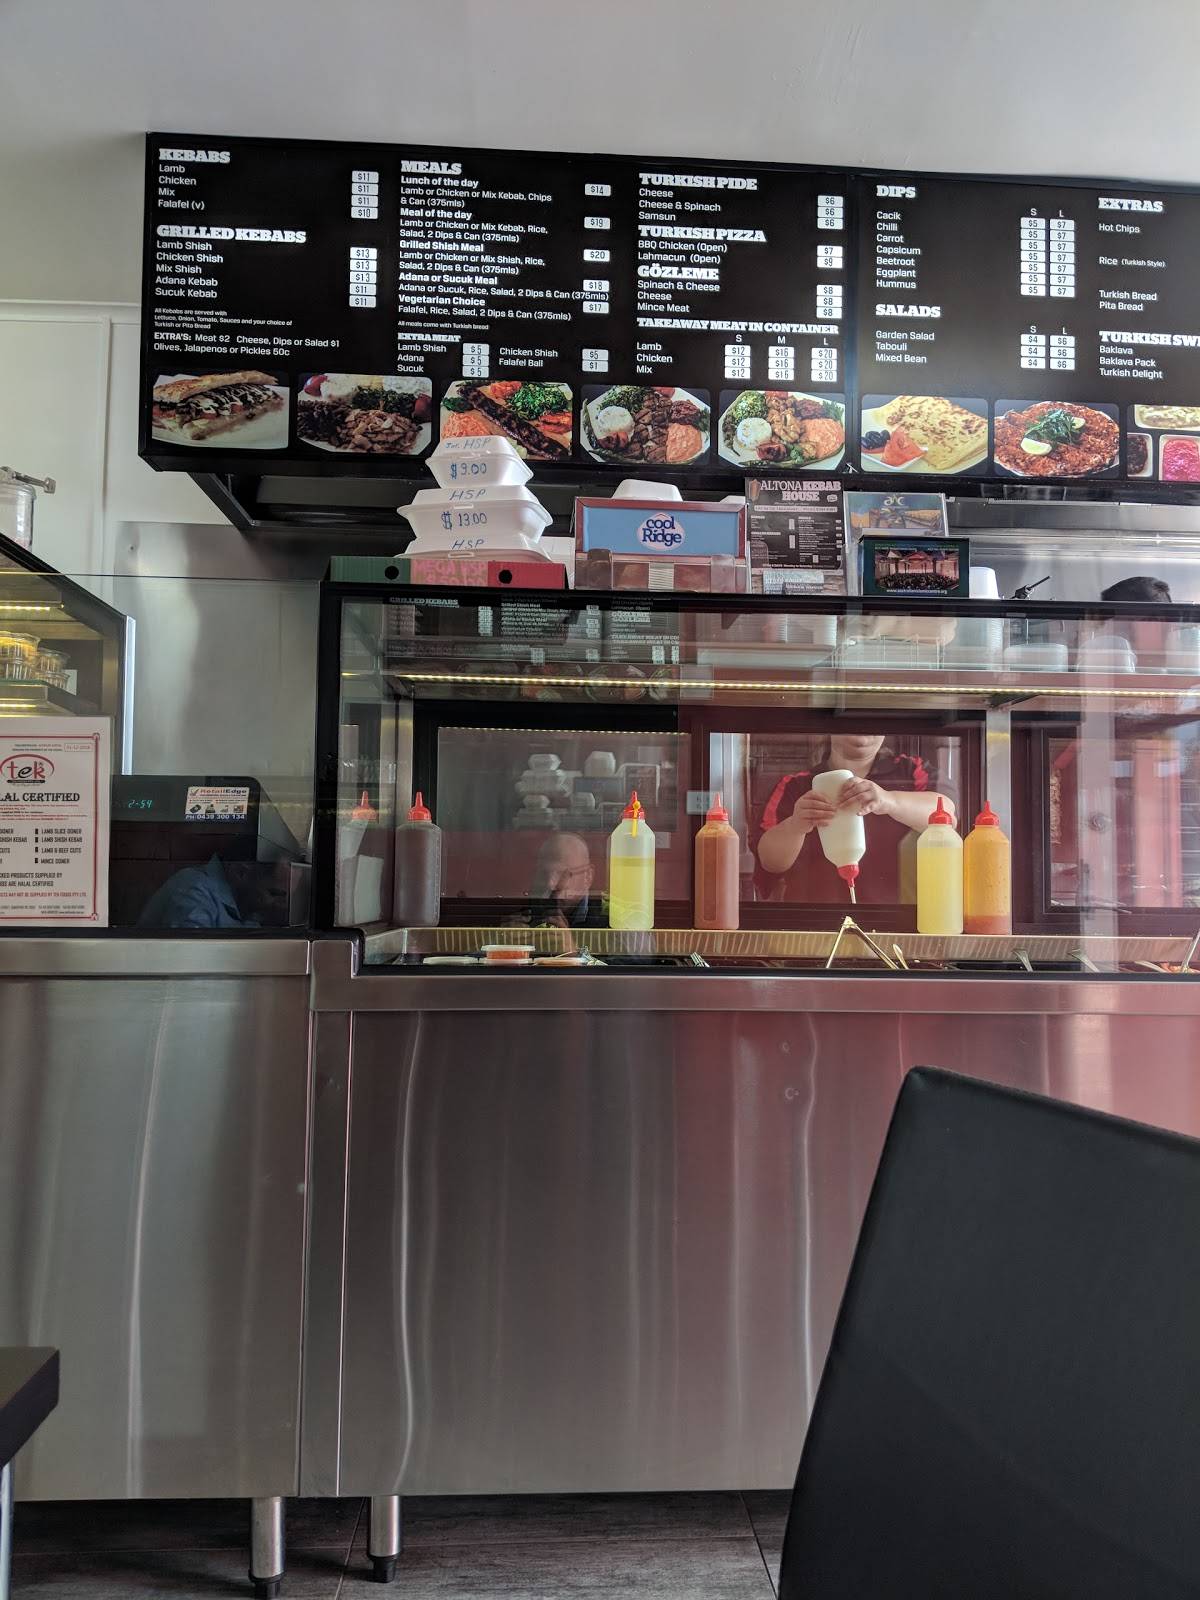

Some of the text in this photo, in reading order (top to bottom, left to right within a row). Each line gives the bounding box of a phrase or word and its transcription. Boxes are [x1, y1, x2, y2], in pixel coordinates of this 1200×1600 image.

[159, 148, 230, 163] KEBABS
[159, 164, 185, 173] Lamb
[401, 160, 462, 175] MEALS
[159, 176, 196, 185] Chicken
[401, 176, 479, 189] Lunch of the day
[639, 173, 757, 190] TURKISH PIDE
[159, 188, 175, 196] Mix
[591, 185, 604, 195] $14
[639, 188, 673, 197] Cheese
[877, 185, 916, 198] DIPS
[158, 199, 205, 210] Falafel (v)
[639, 200, 673, 209] Cheese
[684, 202, 721, 211] Spinach
[1098, 198, 1163, 212] EXTRAS
[358, 209, 370, 217] $10
[400, 208, 472, 220] Meal of the day
[639, 211, 676, 221] Samsun
[877, 211, 901, 220] Cacik
[590, 218, 603, 228] $19
[877, 223, 897, 231] Chilli
[638, 225, 766, 242] TURKISH PIZZA
[1099, 223, 1140, 234] Hot Chips
[157, 225, 306, 243] GRILLED KEBABS
[877, 234, 904, 243] Carrot
[157, 240, 212, 250] Lamb Shish
[400, 240, 484, 252] Grilled Shish Meal
[638, 240, 727, 253] BBQ Chicken (Open)
[877, 245, 921, 255] Capsicum
[157, 252, 223, 263] Chicken Shish
[590, 251, 605, 260] $20
[638, 252, 720, 264] Lahmacun (Open)
[877, 257, 915, 266] Beetroot
[1099, 257, 1118, 265] Rice
[1147, 260, 1166, 268] Style)
[156, 264, 202, 274] Mix Shish
[638, 263, 719, 280] GÖZLEME
[876, 268, 916, 278] Eggplant
[156, 276, 218, 286] Adana Kebab
[399, 272, 429, 281] Adana
[443, 275, 473, 283] Sucuk
[475, 276, 497, 285] Meal
[877, 279, 916, 288] Hummus
[589, 281, 603, 291] $18
[638, 280, 720, 291] Spinach & Cheese
[155, 287, 217, 298] Sucuk Kebab
[638, 291, 672, 300] Cheese
[1099, 290, 1157, 300] Turkish Bread
[399, 294, 485, 306] Vegetarian Choice
[589, 303, 602, 312] $17
[638, 302, 689, 312] Mince Meat
[876, 304, 941, 318] SALADS
[1100, 301, 1143, 311] Pita Bread
[637, 318, 839, 334] TAKEAWAY MEAT IN CONTAINER
[154, 332, 191, 340] EXTRA'S:
[195, 334, 216, 342] Meat
[237, 336, 271, 345] Cheese,
[273, 337, 292, 346] Dips
[736, 334, 742, 342] S
[778, 336, 785, 344] M
[876, 330, 934, 340] Garden Salad
[1099, 331, 1172, 345] TURKISH
[305, 339, 328, 347] Salad
[398, 343, 446, 352] Lamb Shish
[637, 342, 662, 350] Lamb
[876, 342, 907, 351] Tabouli
[154, 343, 182, 351] Olives,
[184, 344, 227, 353] Jalapenos
[240, 347, 271, 355] Pickles
[273, 348, 290, 356] 50c
[500, 348, 558, 357] Chicken Shish
[1100, 345, 1133, 354] Baklava
[397, 354, 424, 362] Adana
[499, 358, 543, 367] Falafel Ball
[637, 353, 672, 363] Chicken
[876, 353, 927, 363] Mixed Bean
[1100, 357, 1156, 367] Baklava Pack
[397, 364, 424, 372] Sucuk
[637, 365, 652, 373] Mix
[1099, 368, 1163, 379] Turkish Delight
[760, 481, 841, 491] ALTONA KEBAB
[450, 489, 486, 500] HSP
[782, 491, 820, 501] HOUSE
[646, 517, 675, 530] cool
[642, 528, 682, 546] Ridge
[452, 539, 485, 549] HSP
[7, 761, 45, 779] tek
[22, 793, 80, 801] CERTIFIED
